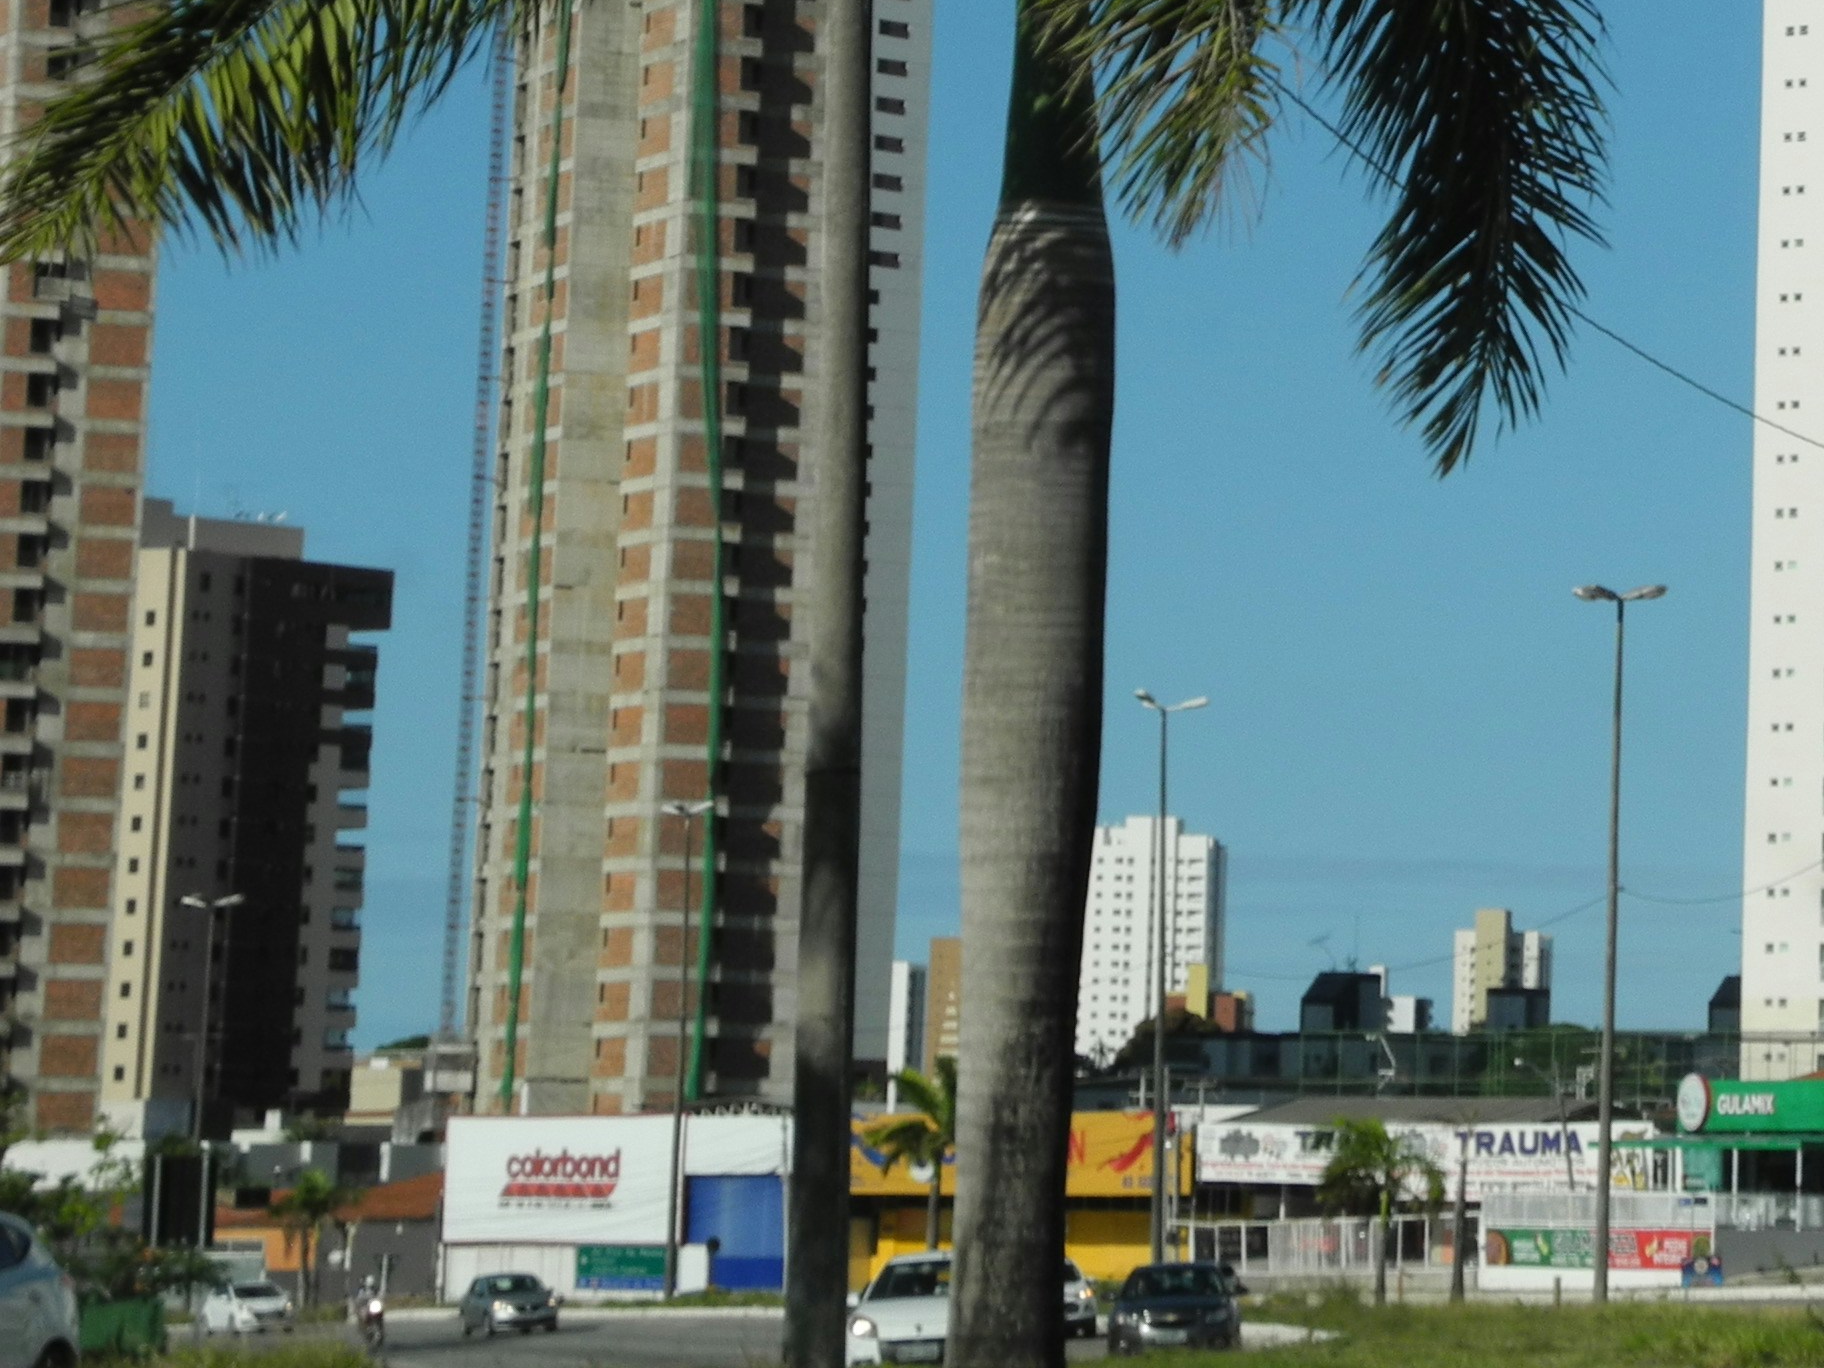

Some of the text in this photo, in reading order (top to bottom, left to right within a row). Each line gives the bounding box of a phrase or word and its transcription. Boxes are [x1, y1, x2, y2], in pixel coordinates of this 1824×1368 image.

[1717, 1093, 1775, 1116] GULAMIX
[1455, 1130, 1582, 1156] TRAUMA
[507, 1147, 621, 1179] colorbond
